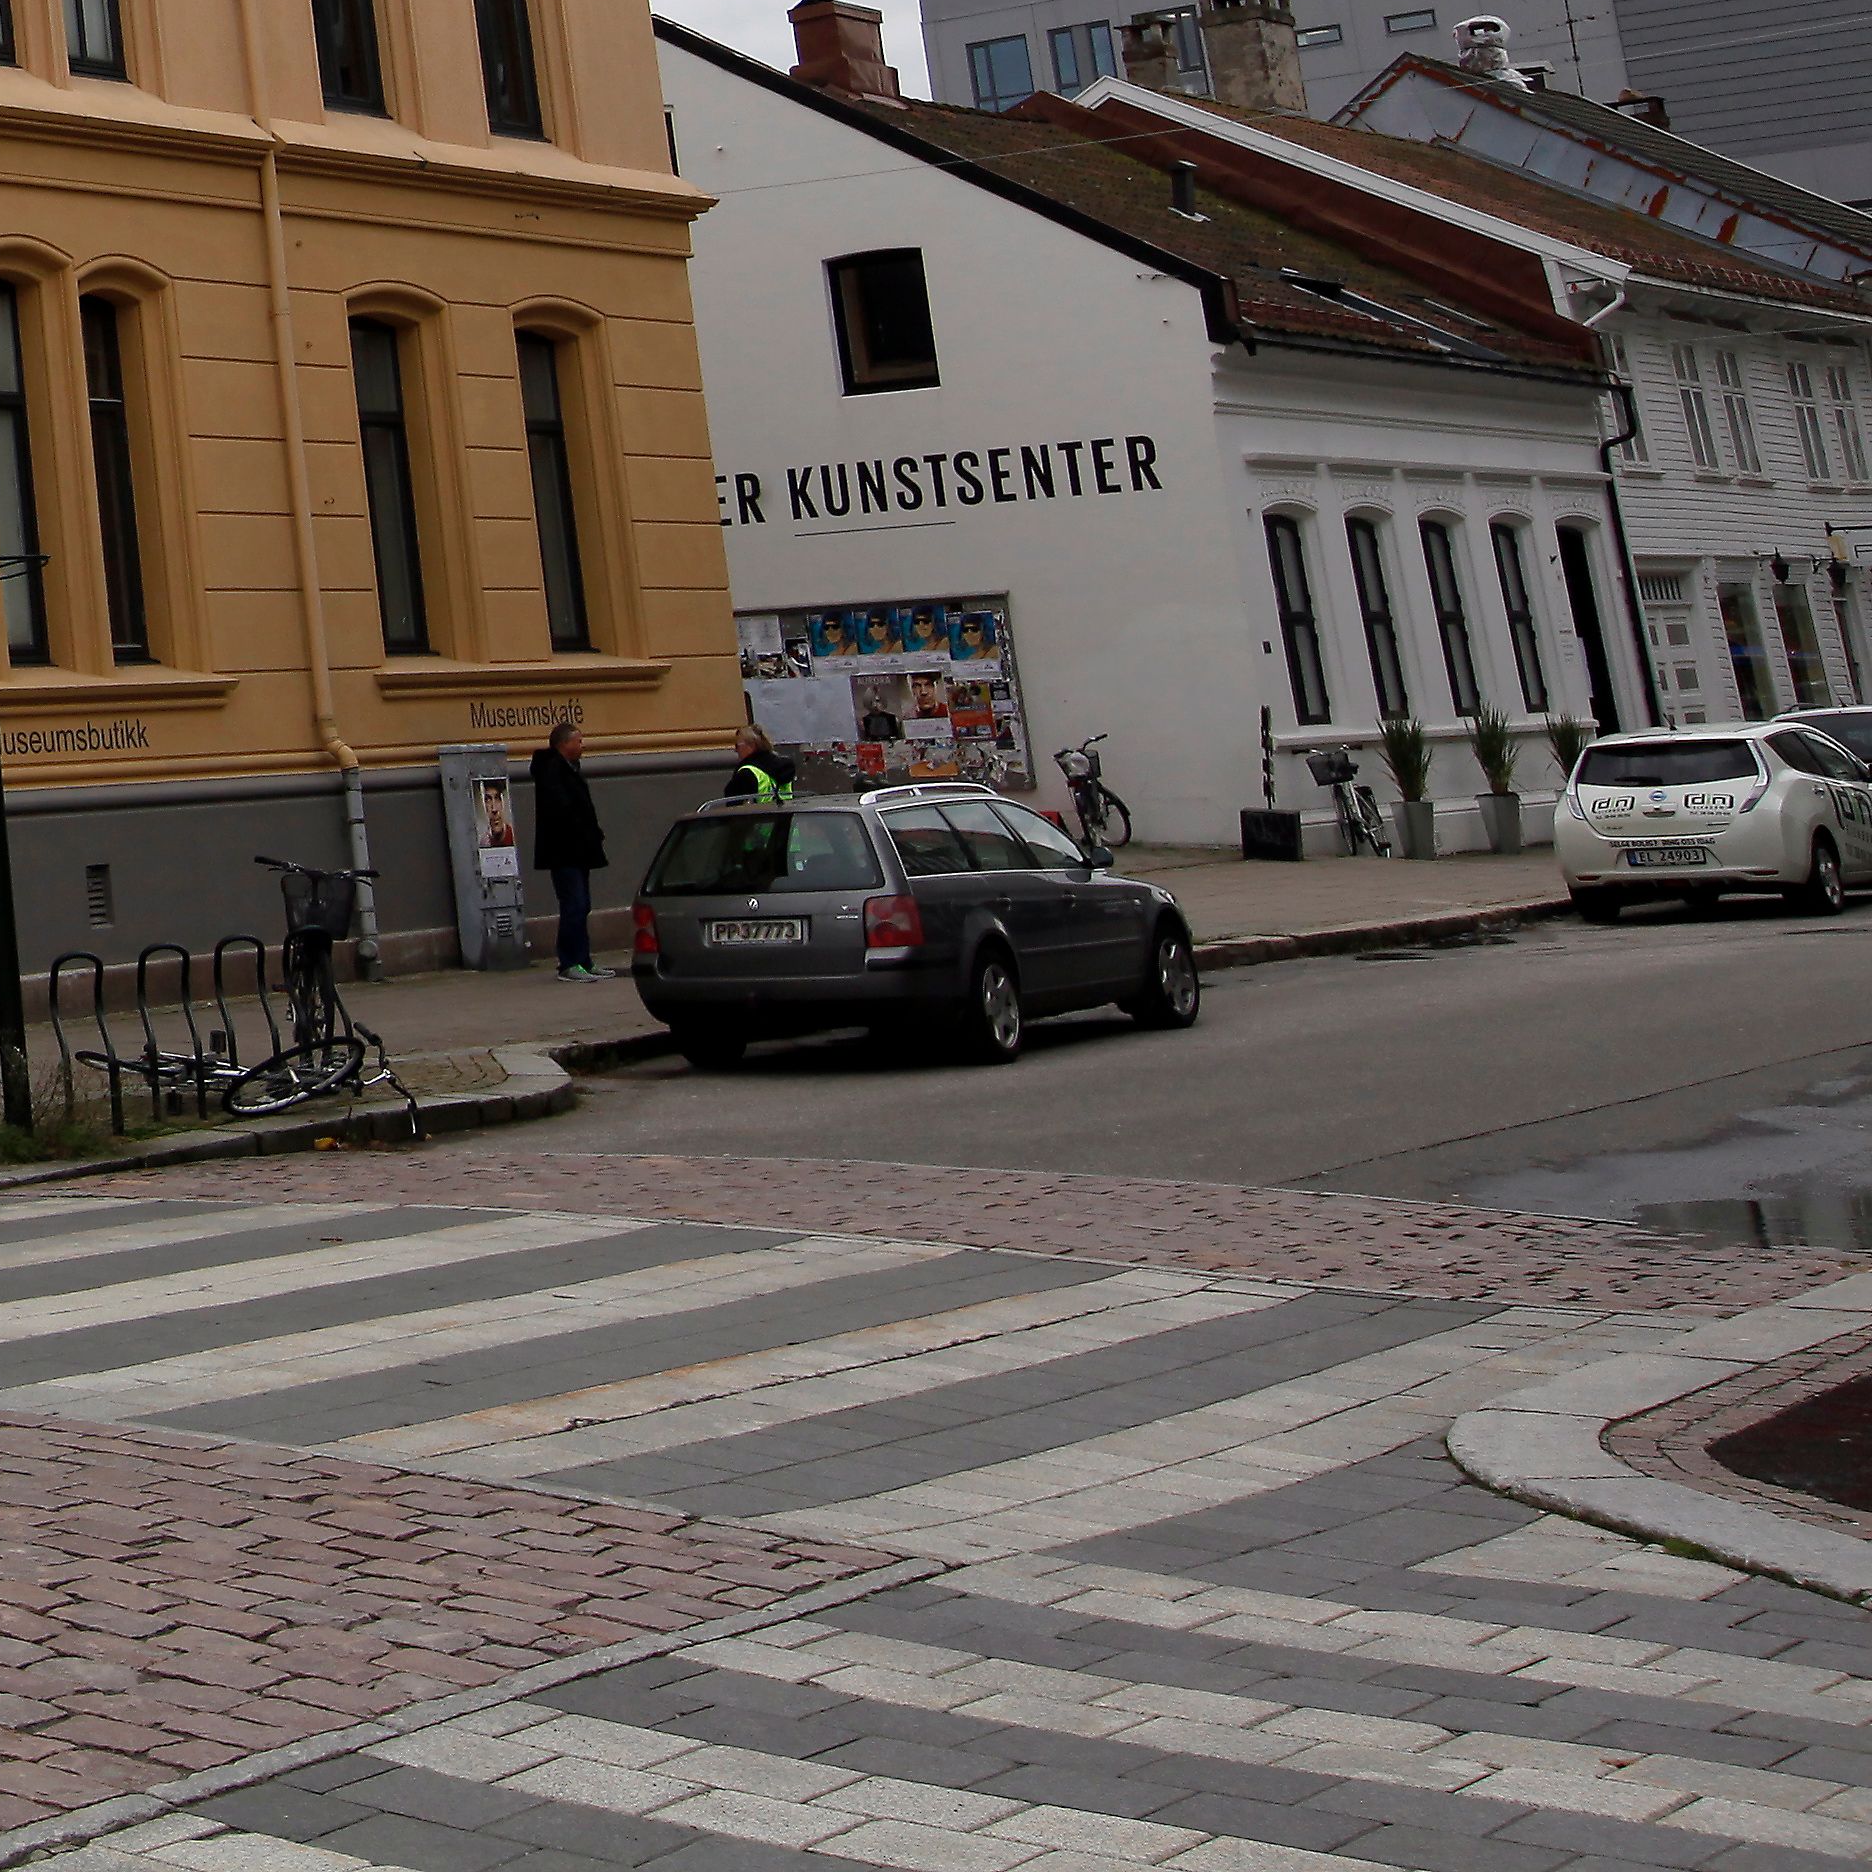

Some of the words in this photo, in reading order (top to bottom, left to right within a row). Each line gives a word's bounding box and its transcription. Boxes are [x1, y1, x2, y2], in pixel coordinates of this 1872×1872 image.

[785, 434, 1163, 520] KUNSTSENTER
[469, 698, 584, 728] Museumskafé
[1659, 849, 1701, 862] 24903
